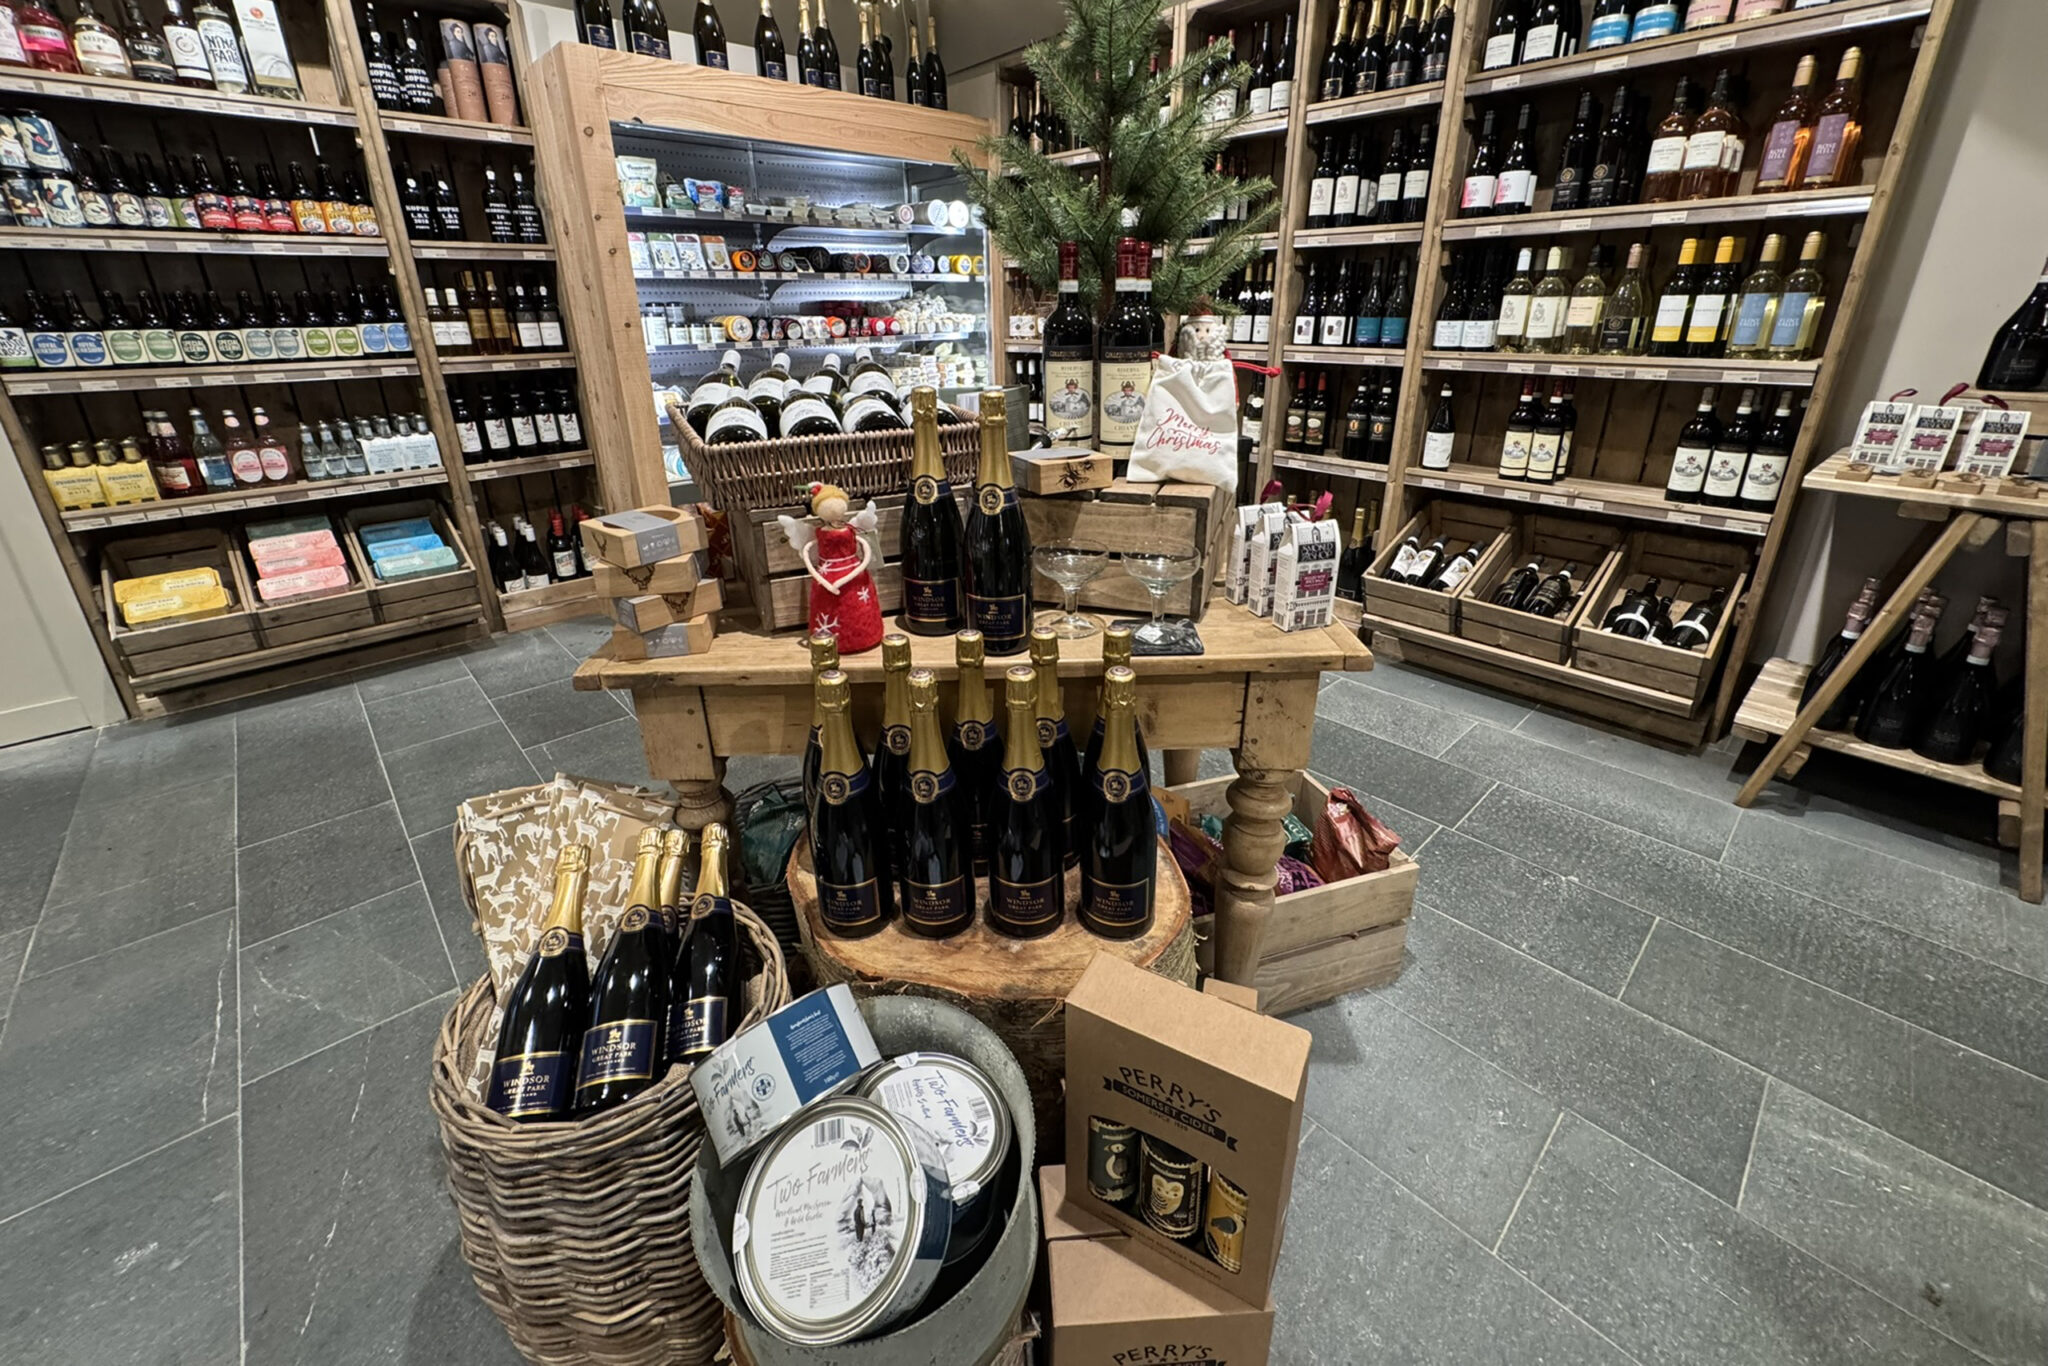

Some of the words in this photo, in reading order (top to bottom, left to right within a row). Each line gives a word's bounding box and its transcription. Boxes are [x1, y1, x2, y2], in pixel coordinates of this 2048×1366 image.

[207, 35, 236, 50] NINE
[208, 50, 240, 64] TAILS
[368, 62, 392, 70] PORTO
[404, 68, 427, 76] PORTO
[369, 69, 396, 79] KOPKE
[405, 75, 430, 83] KOPKE
[1156, 407, 1211, 438] Merry
[1146, 426, 1221, 455] Christmas
[913, 898, 950, 906] WINDSOR
[1006, 898, 1044, 906] WINDSOR
[1095, 897, 1134, 906] WINDSOR
[592, 1041, 636, 1056] WINDSOR
[592, 1052, 613, 1063] GREAT
[614, 1051, 633, 1059] PARK
[503, 1074, 550, 1088] WINDSOR
[713, 1056, 755, 1105] Farmers
[503, 1086, 525, 1095] GREAT
[527, 1084, 546, 1092] PARK
[1118, 1066, 1222, 1124] PERRY'S
[924, 1070, 949, 1097] Two
[937, 1098, 975, 1148] Farmers
[1122, 1084, 1179, 1119] SOMERSET
[1180, 1113, 1217, 1136] CIDER
[766, 1173, 804, 1210] Two
[806, 1147, 872, 1194] Farmers
[1112, 1344, 1213, 1366] PERRY'S
